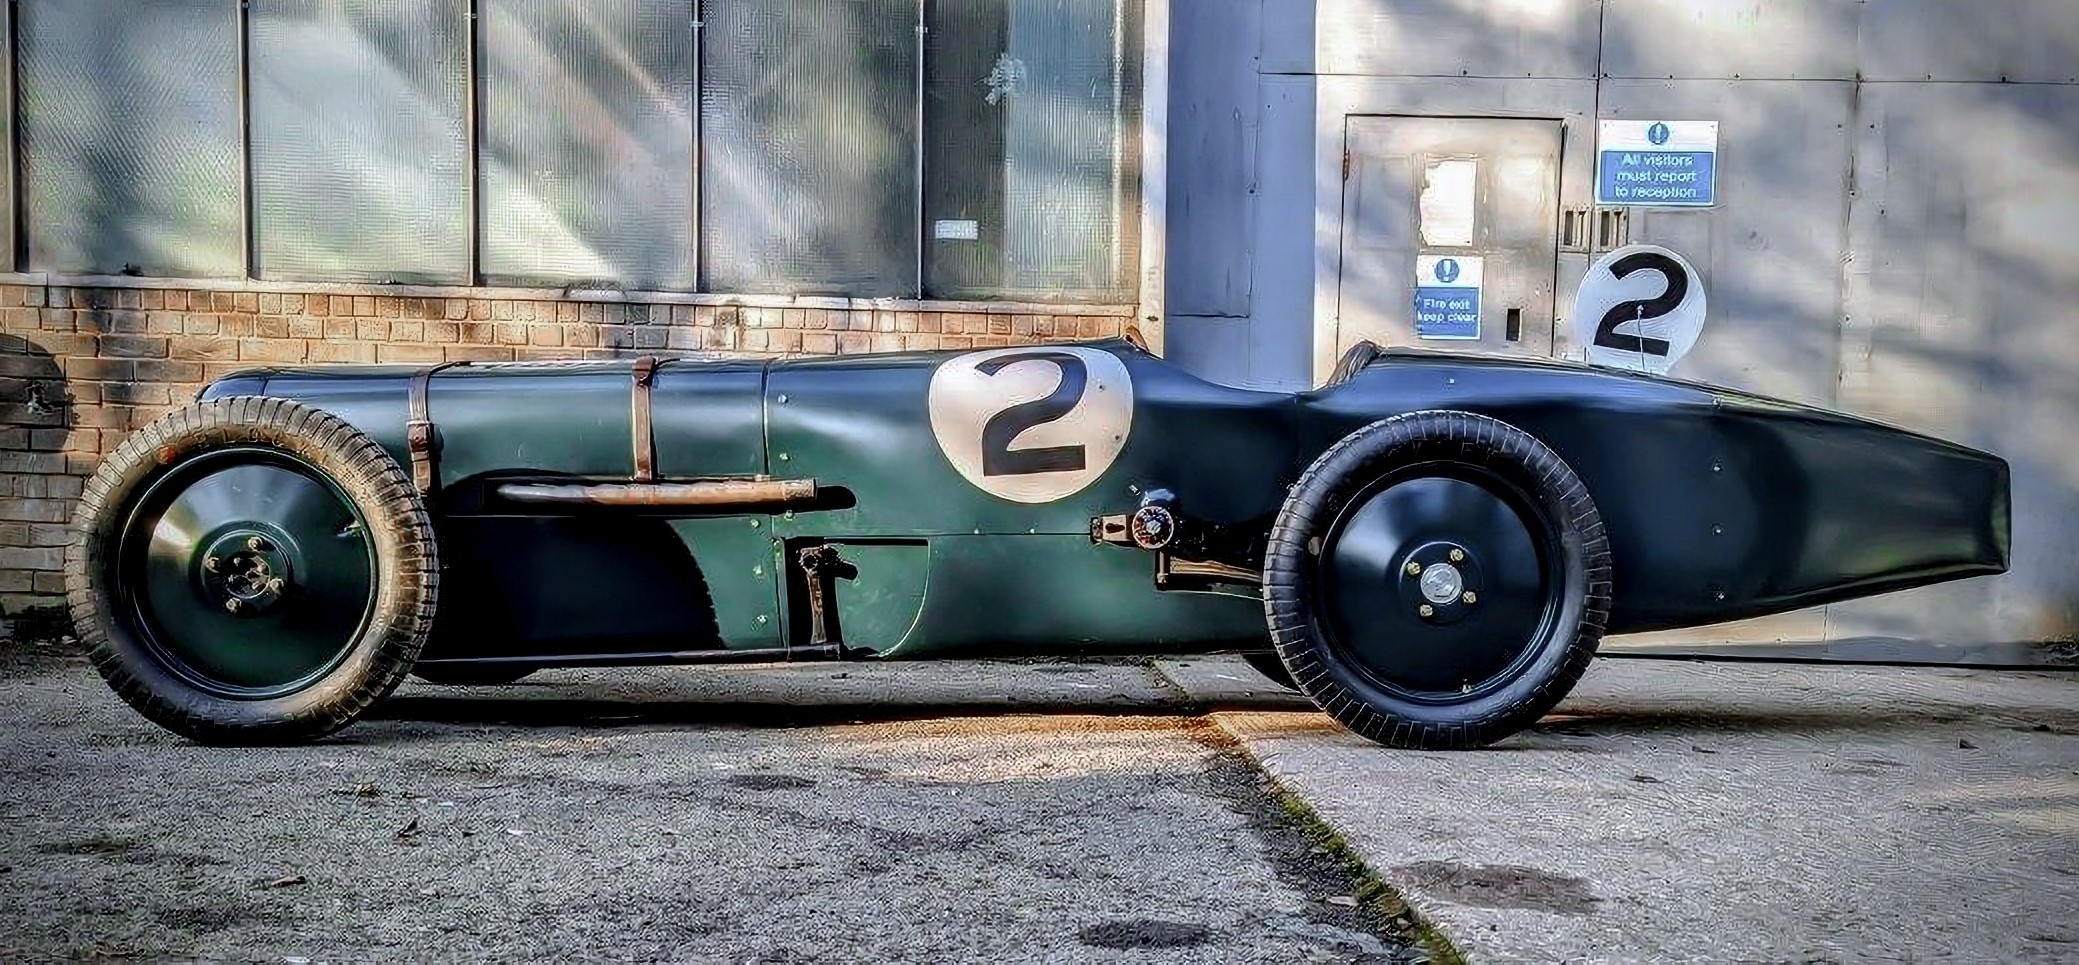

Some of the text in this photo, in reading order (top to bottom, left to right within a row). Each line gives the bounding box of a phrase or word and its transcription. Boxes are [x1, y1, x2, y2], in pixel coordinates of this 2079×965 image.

[1621, 153, 1694, 167] All visitors
[1616, 170, 1698, 183] must report
[1615, 186, 1697, 199] to reception
[1423, 298, 1446, 309] Fire
[1593, 252, 1688, 356] 2
[974, 352, 1088, 477] 2
